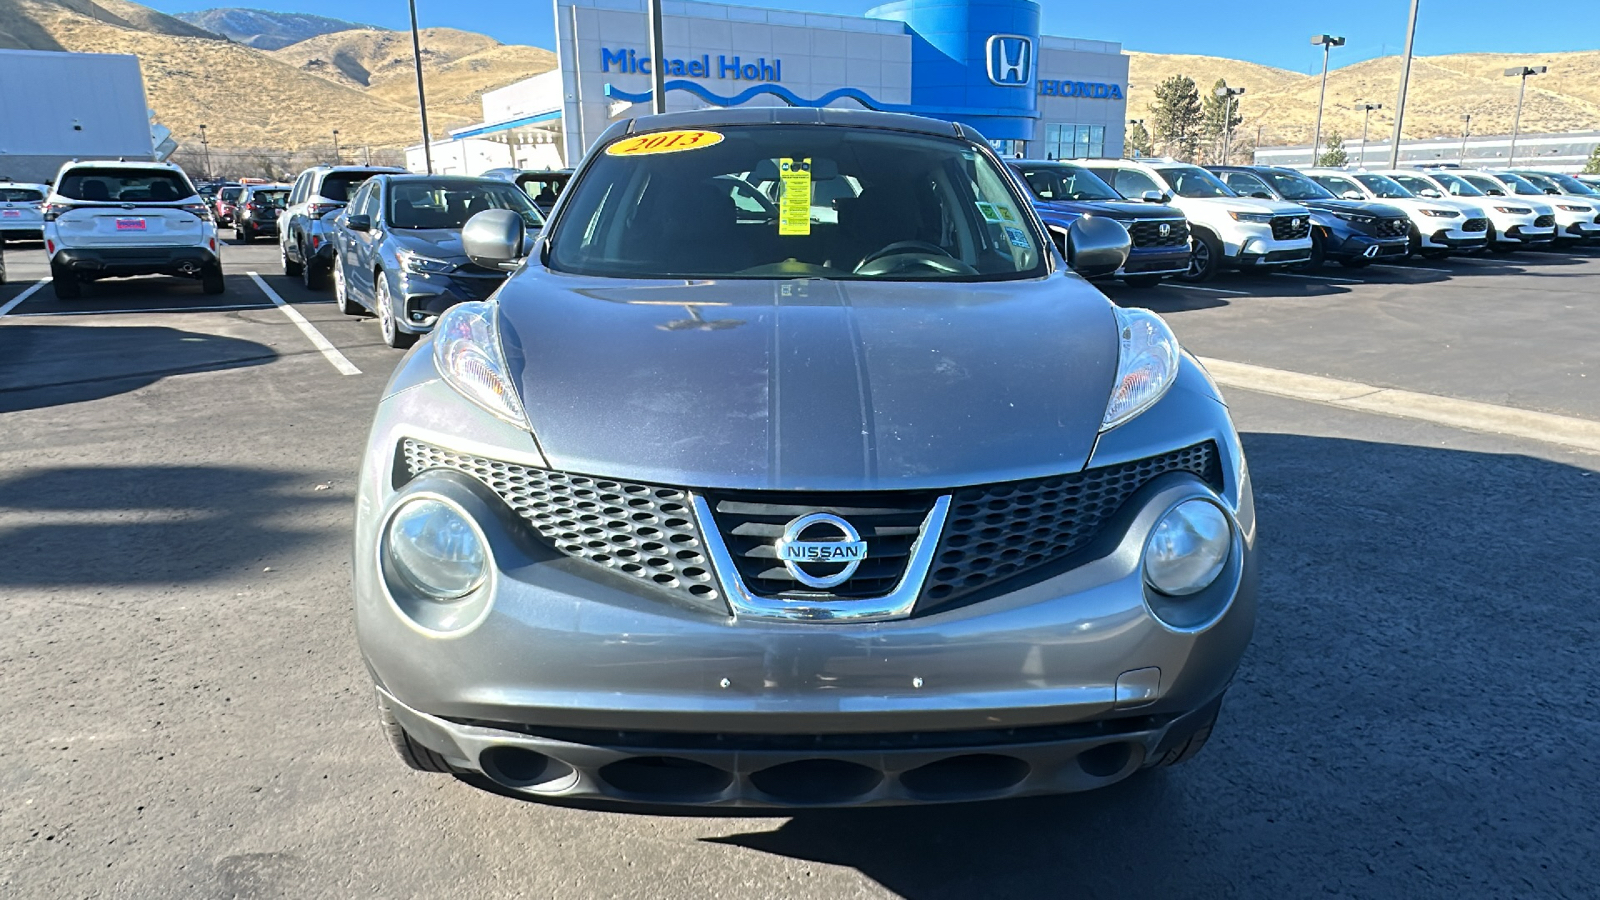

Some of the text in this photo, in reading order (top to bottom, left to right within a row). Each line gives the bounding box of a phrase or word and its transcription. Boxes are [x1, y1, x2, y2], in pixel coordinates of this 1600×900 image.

[718, 54, 782, 82] Hohl
[1037, 79, 1124, 100] HONDA
[624, 132, 705, 152] 2013
[787, 546, 858, 558] NISSAN
